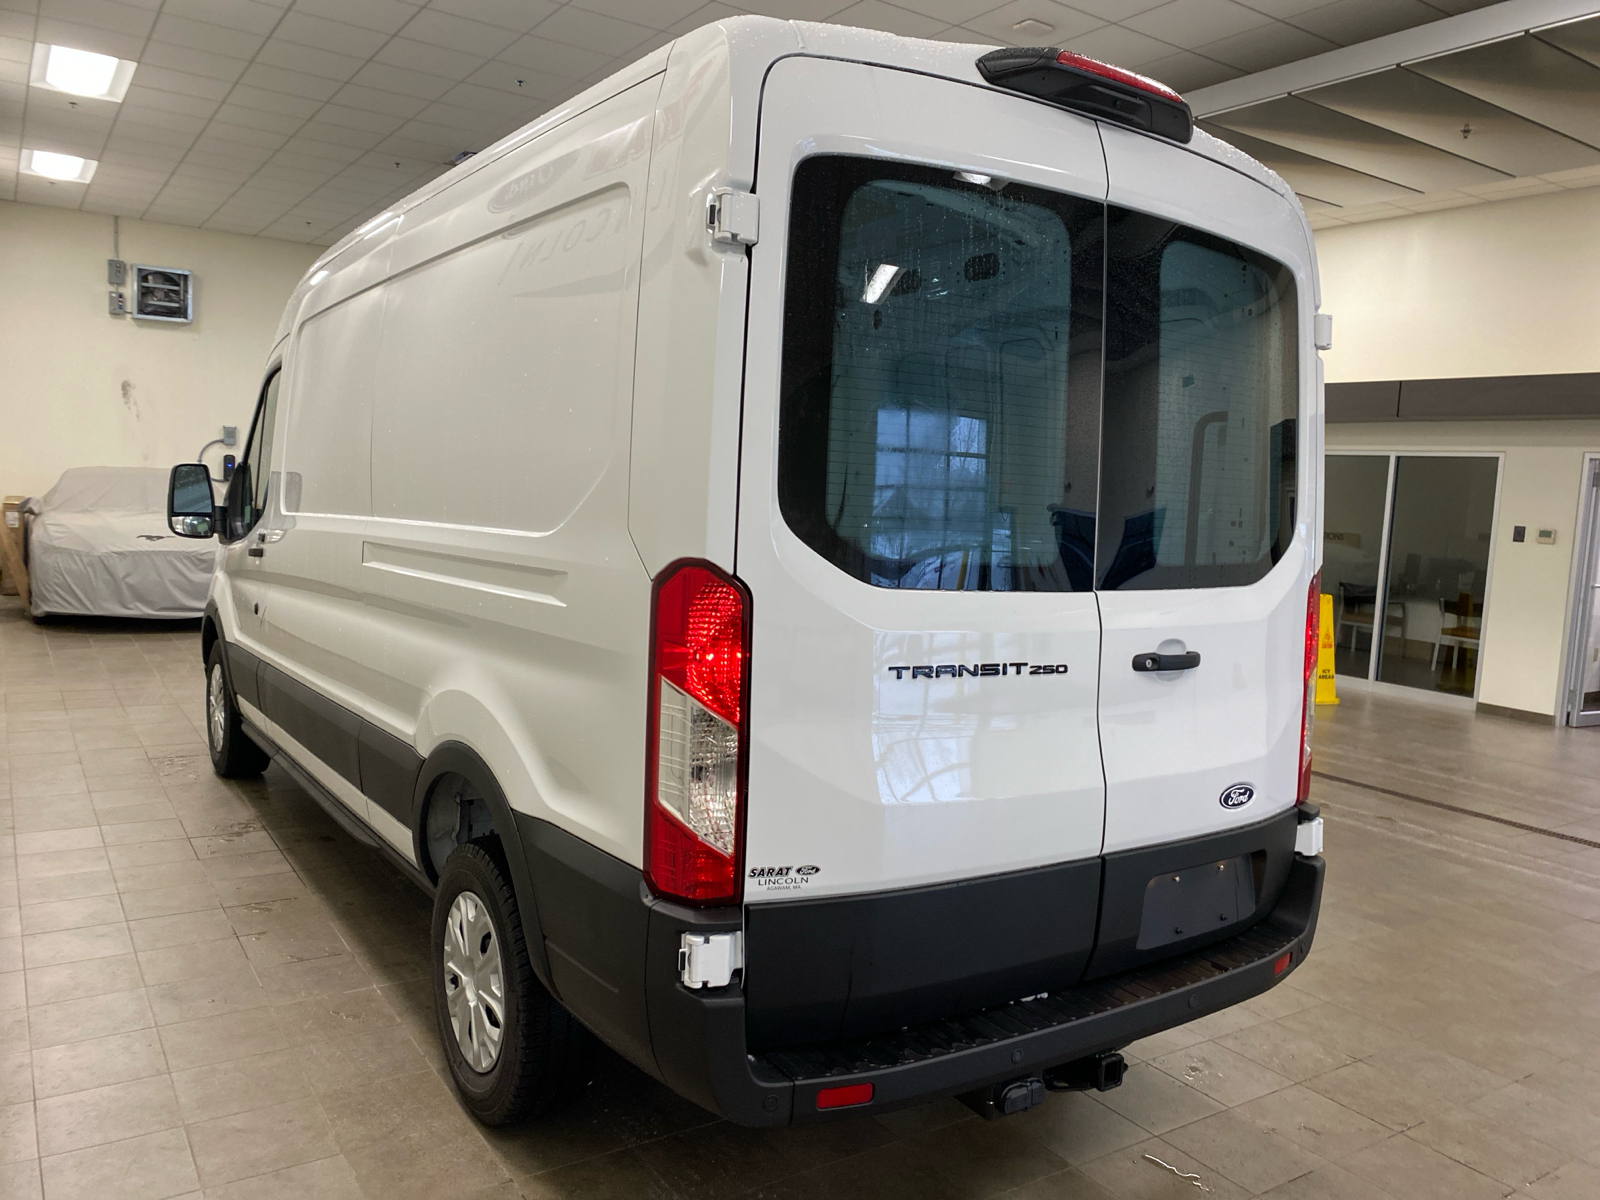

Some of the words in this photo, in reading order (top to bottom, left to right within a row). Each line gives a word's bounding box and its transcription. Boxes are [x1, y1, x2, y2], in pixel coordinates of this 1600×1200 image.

[888, 662, 1028, 679] TRANSIT
[1029, 664, 1068, 675] 250
[1226, 787, 1251, 806] Ford
[749, 866, 792, 877] SARAT
[799, 866, 818, 875] Ford
[758, 877, 809, 886] LINCOLN
